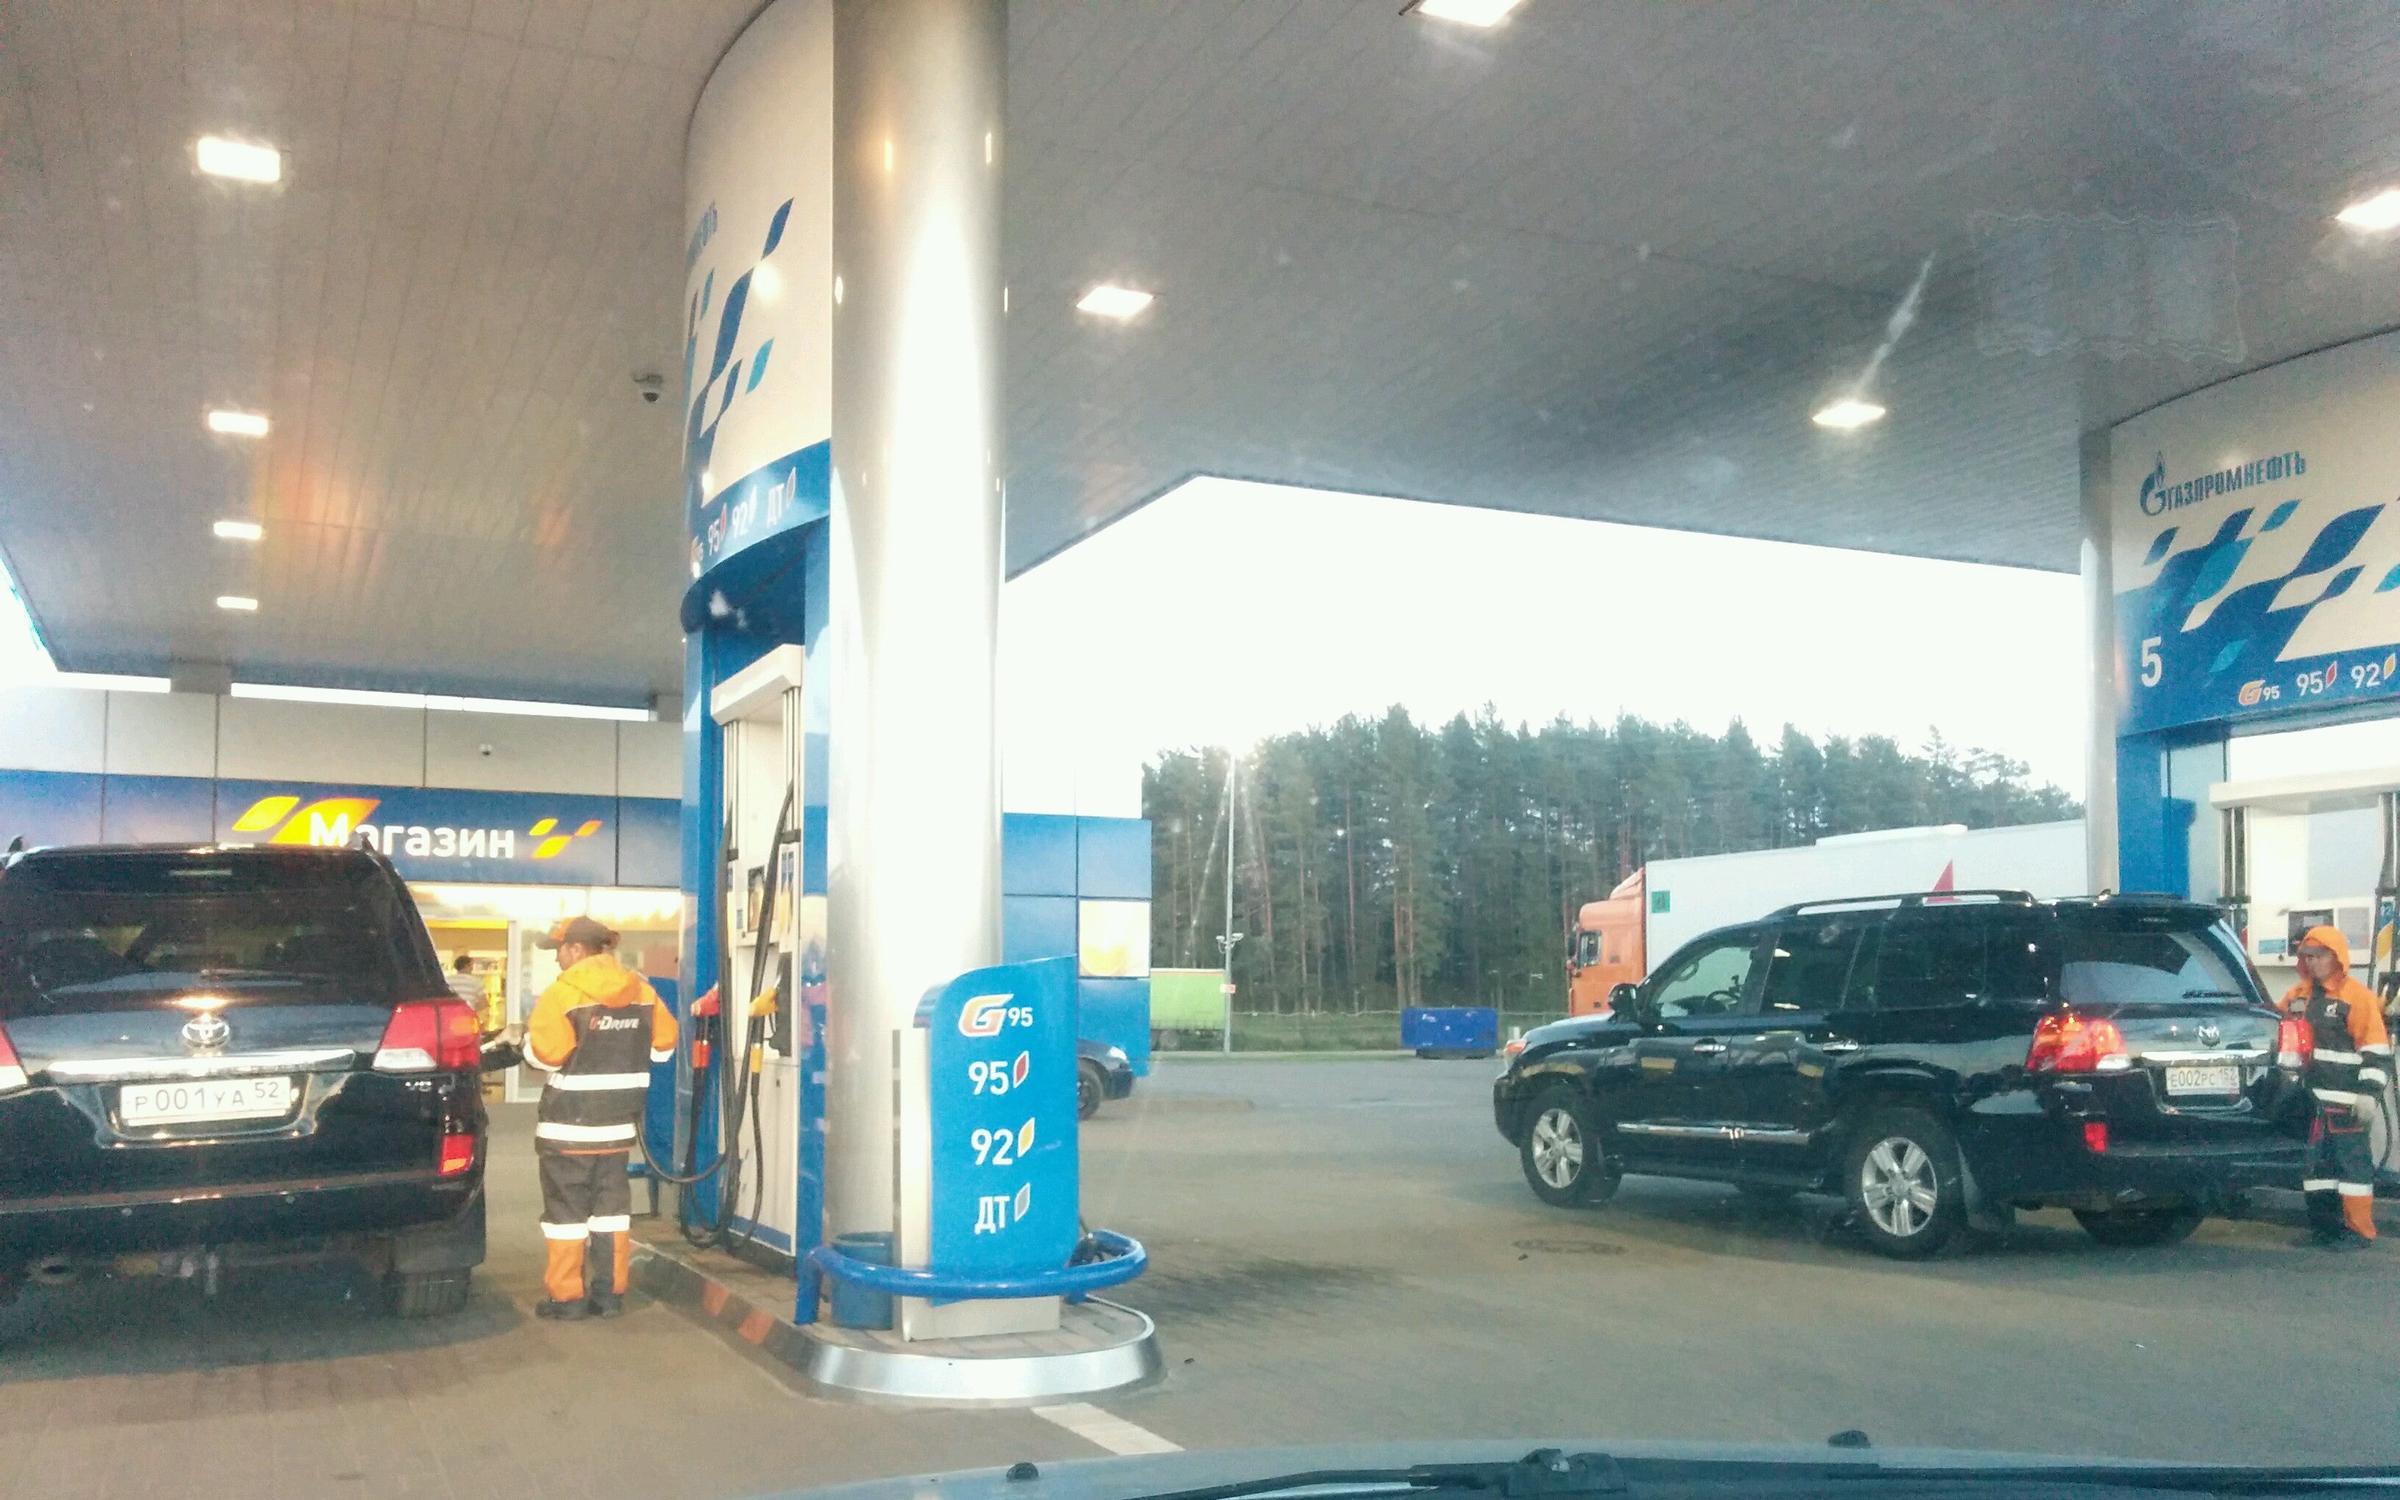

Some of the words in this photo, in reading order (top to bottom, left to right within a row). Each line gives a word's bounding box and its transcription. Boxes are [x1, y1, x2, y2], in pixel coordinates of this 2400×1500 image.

[2167, 451, 2306, 510] ГАЗПРОМНЕФТЬ
[732, 500, 748, 538] 92
[2141, 636, 2162, 687] 5
[2296, 671, 2323, 696] 95
[2351, 663, 2381, 688] 92
[309, 811, 514, 858] Магазин
[254, 1082, 279, 1098] 52
[968, 1061, 1009, 1096] 95
[971, 1129, 1014, 1165] 92
[975, 1196, 1010, 1235] ДТ
